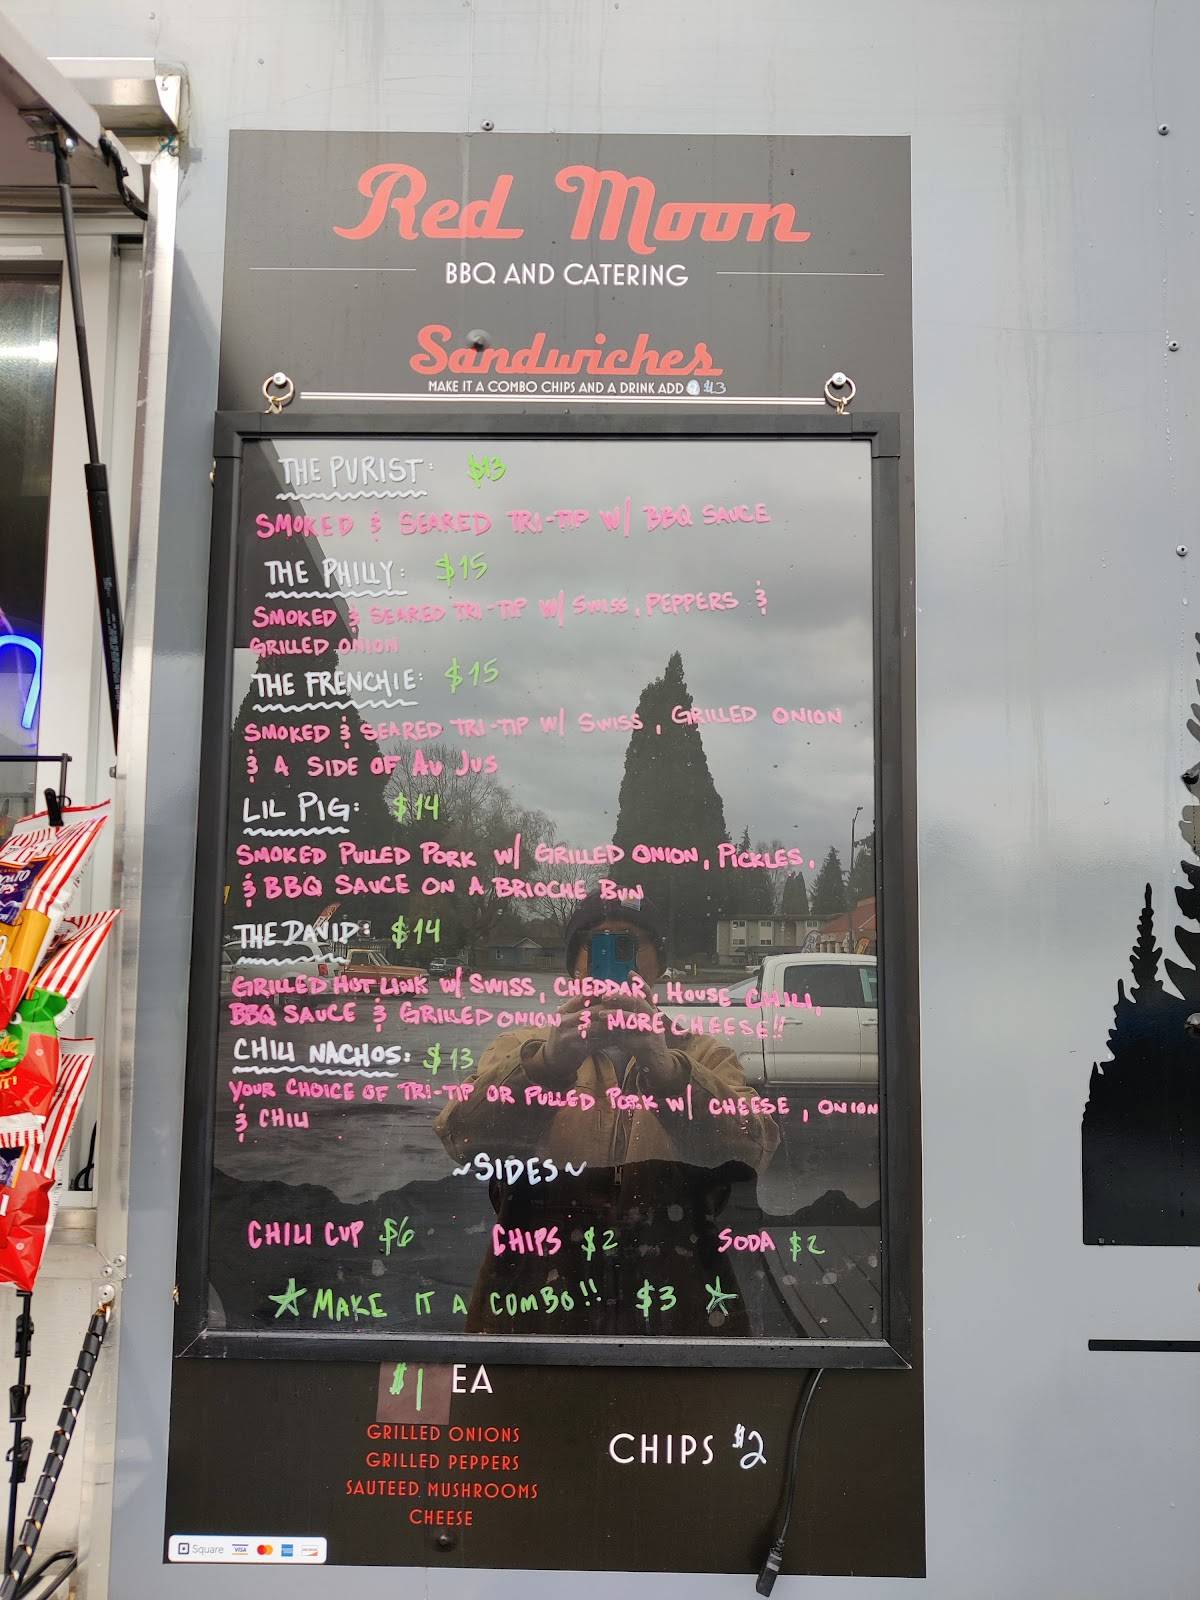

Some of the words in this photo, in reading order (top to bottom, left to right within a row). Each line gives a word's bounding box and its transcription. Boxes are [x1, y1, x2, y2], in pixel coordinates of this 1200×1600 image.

[332, 163, 525, 241] Red
[555, 164, 811, 256] Moon
[445, 262, 496, 286] BBQ
[503, 263, 555, 285] AND
[563, 262, 689, 287] CATERING
[409, 324, 724, 376] Sandwiches
[428, 379, 459, 392] MAKE
[462, 379, 473, 392] IT
[475, 379, 485, 392] A
[487, 379, 538, 393] COMBO
[541, 380, 576, 393] CHIPS
[578, 380, 604, 393] AND
[607, 381, 617, 394] A
[620, 380, 655, 394] DRINK
[658, 381, 684, 394] ADD
[278, 456, 322, 486] THE
[255, 512, 354, 540] SMOKED
[400, 509, 492, 536] SEARED
[507, 508, 590, 534] TRI-TIP
[643, 505, 693, 532] BBQ
[703, 503, 771, 527] SAUCE
[264, 559, 309, 587] THE
[252, 605, 337, 628] SMOKED
[367, 603, 446, 625] SEARED
[452, 597, 528, 622] TRI-TIP
[646, 591, 739, 617] PEPPERS
[249, 636, 329, 658] GRILLED
[337, 637, 401, 654] ONION
[251, 671, 296, 699] THE
[244, 722, 331, 744] SMOKED
[359, 720, 443, 743] SEARED
[450, 715, 529, 738] TRI-TIP
[671, 704, 758, 726] GRILLED
[772, 706, 843, 726] ONION
[274, 754, 290, 777] A
[307, 755, 359, 777] SIDE
[370, 754, 401, 776] OF
[455, 750, 498, 777] JUS
[242, 797, 286, 823] LIL
[236, 844, 328, 866] SMOKED
[338, 841, 411, 866] PULLED
[419, 841, 477, 868] PORK
[534, 843, 625, 868] GRILLED
[264, 875, 323, 900] BBQ
[334, 873, 411, 896] SAUCE
[421, 876, 455, 897] ON
[468, 875, 485, 897] A
[494, 877, 588, 900] BRIOCHE
[599, 878, 645, 901] BUN
[232, 922, 278, 950] THE
[231, 975, 328, 998] GRILLED
[667, 981, 732, 1008] HOUSE
[228, 1002, 277, 1026] BBQ
[284, 1001, 356, 1025] SAUCE
[399, 1000, 494, 1026] GRILLED
[496, 1010, 562, 1028] ONION
[606, 1008, 666, 1035] MORE
[233, 1036, 295, 1063] CHILI
[229, 1080, 277, 1103] YOUR
[285, 1078, 356, 1101] CHOICE
[361, 1084, 390, 1102] OF
[397, 1081, 475, 1102] TRI-TIP
[486, 1086, 516, 1105] OR
[524, 1085, 596, 1110] PULLED
[606, 1086, 660, 1111] PORK
[817, 1099, 880, 1115] ONION
[259, 1107, 310, 1130] CHILI
[247, 1219, 313, 1250] CHILI
[324, 1220, 365, 1249] CUP
[378, 1215, 416, 1256] $6
[492, 1223, 564, 1257] CHIPS
[717, 1228, 777, 1254] SODA
[312, 1287, 388, 1322] MAKE
[415, 1291, 436, 1316] IT
[452, 1293, 469, 1316] A
[635, 1278, 678, 1318] $3
[389, 1361, 425, 1412] $1
[452, 1364, 494, 1395] EA
[366, 1423, 441, 1442] GRILLED
[448, 1426, 521, 1444] ONIONS
[608, 1432, 714, 1466] CHIPS
[731, 1423, 768, 1470] $2
[366, 1451, 441, 1469] GRILLED
[448, 1454, 520, 1471] PEPPERS
[346, 1479, 421, 1497] SAUTEED
[427, 1482, 539, 1500] MUSHROOMS
[409, 1508, 474, 1527] CHEESE
[192, 1544, 224, 1556] Square
